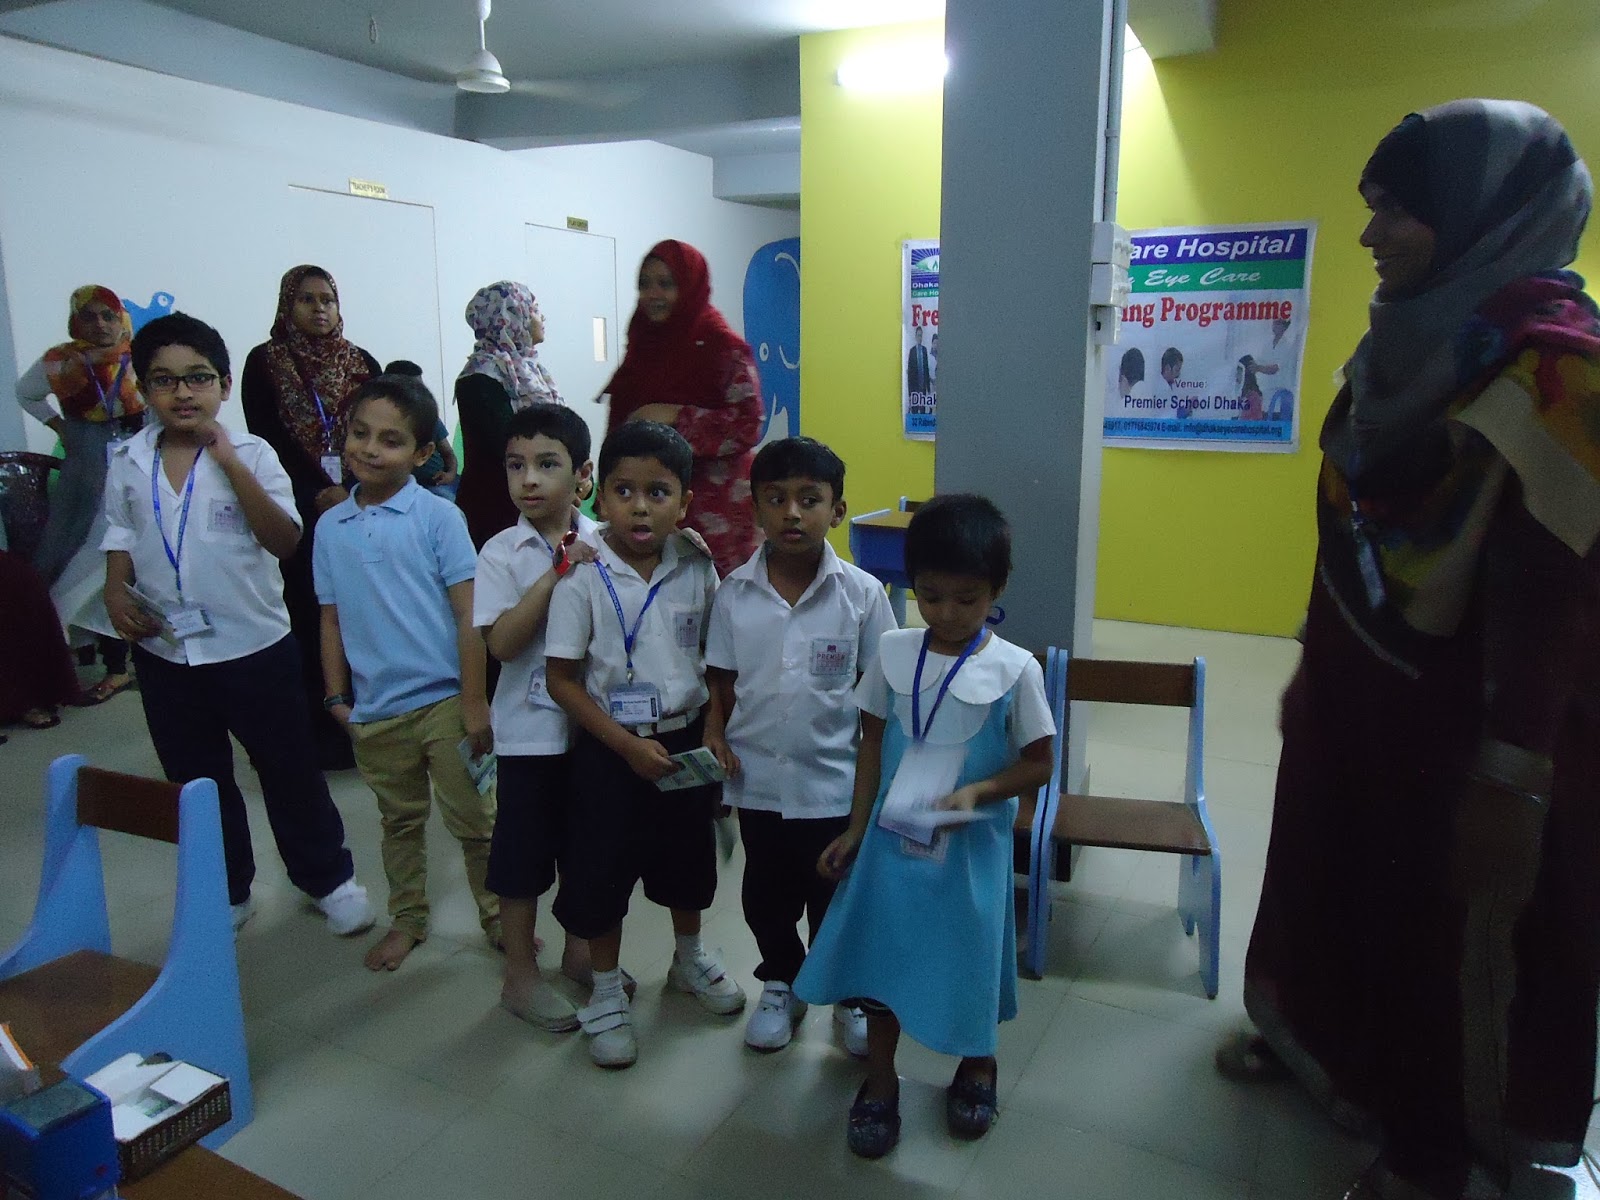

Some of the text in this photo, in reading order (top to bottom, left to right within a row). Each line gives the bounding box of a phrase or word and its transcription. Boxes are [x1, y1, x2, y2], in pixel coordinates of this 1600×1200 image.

[1130, 234, 1291, 260] are Hospital
[1145, 269, 1190, 288] Eye
[1200, 268, 1261, 286] Care
[1160, 296, 1291, 328] Programme
[1174, 379, 1208, 389] Venue:
[1124, 395, 1251, 410] Premier School Dhaka
